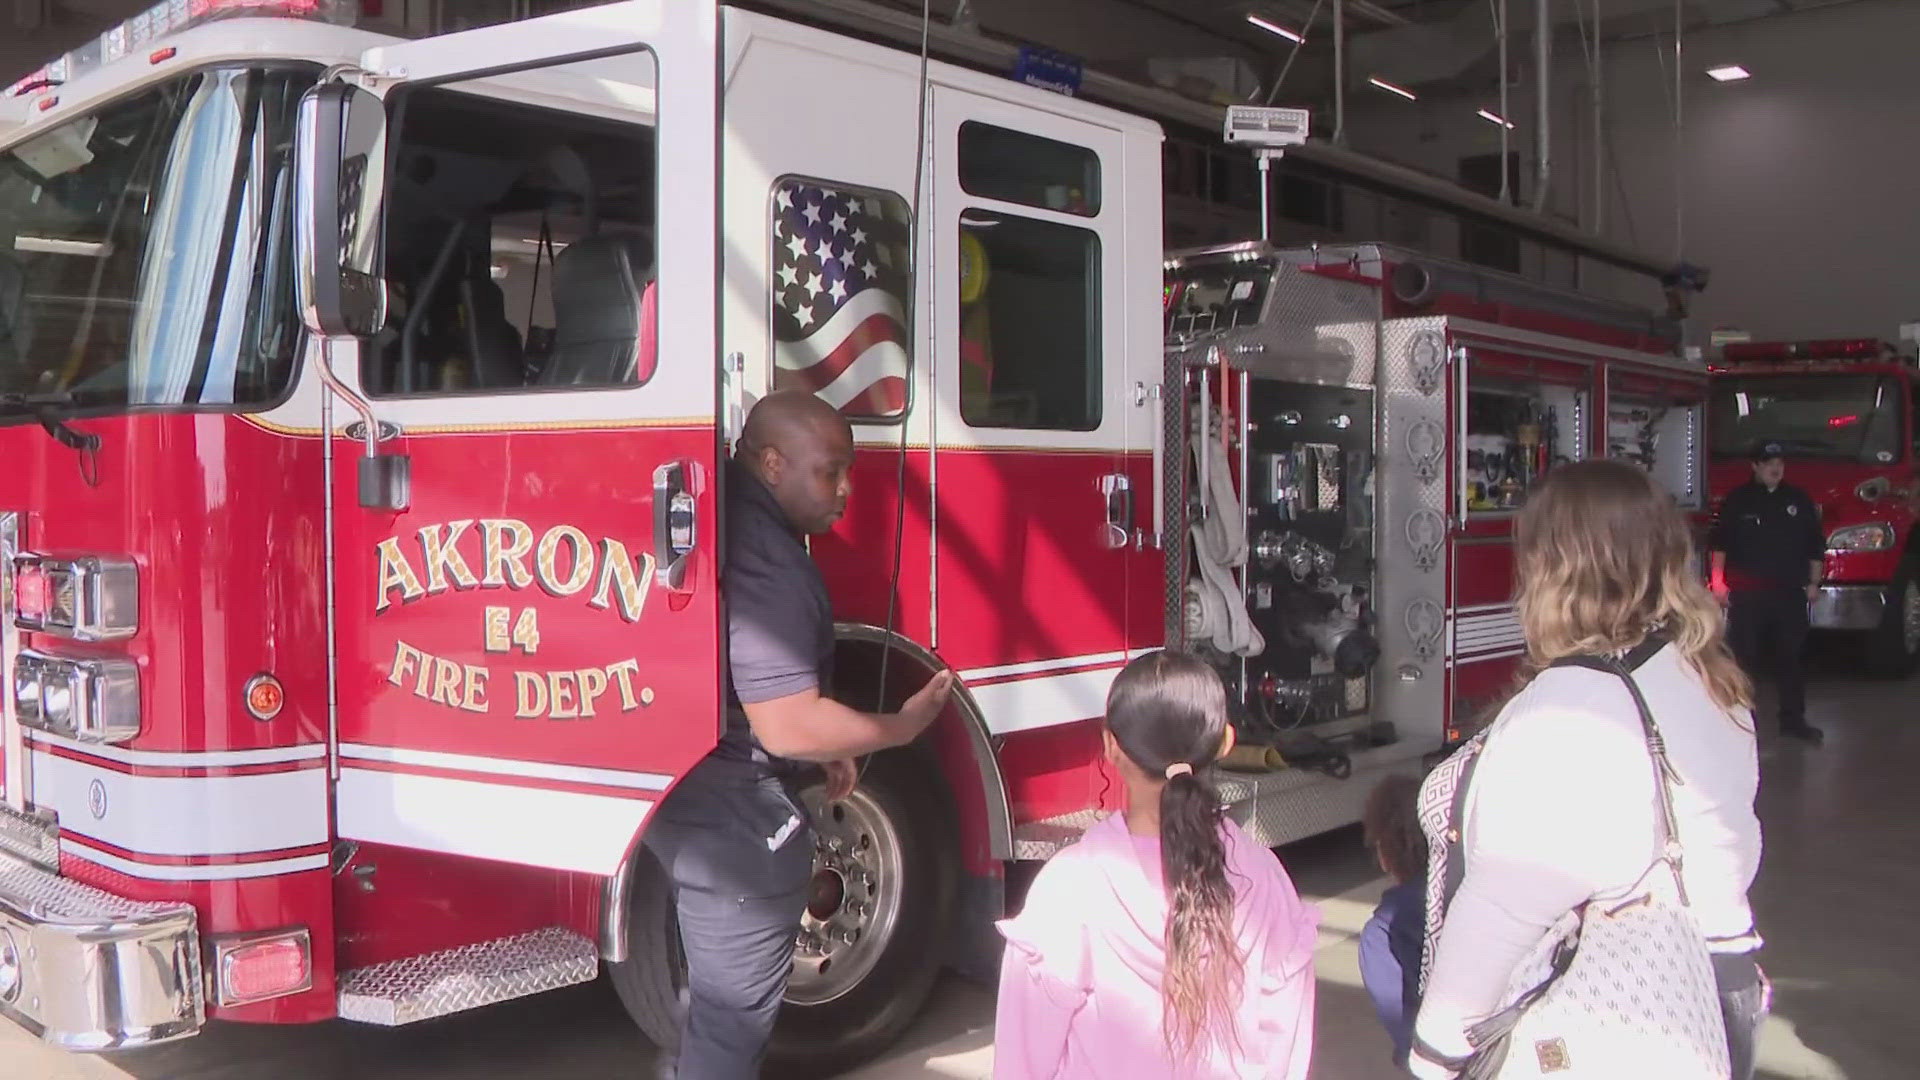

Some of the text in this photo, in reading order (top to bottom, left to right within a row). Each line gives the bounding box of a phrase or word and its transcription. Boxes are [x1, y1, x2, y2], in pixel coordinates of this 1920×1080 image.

[375, 518, 656, 623] AKRON
[484, 605, 540, 654] E4
[387, 639, 655, 720] FIRE DEPT.
